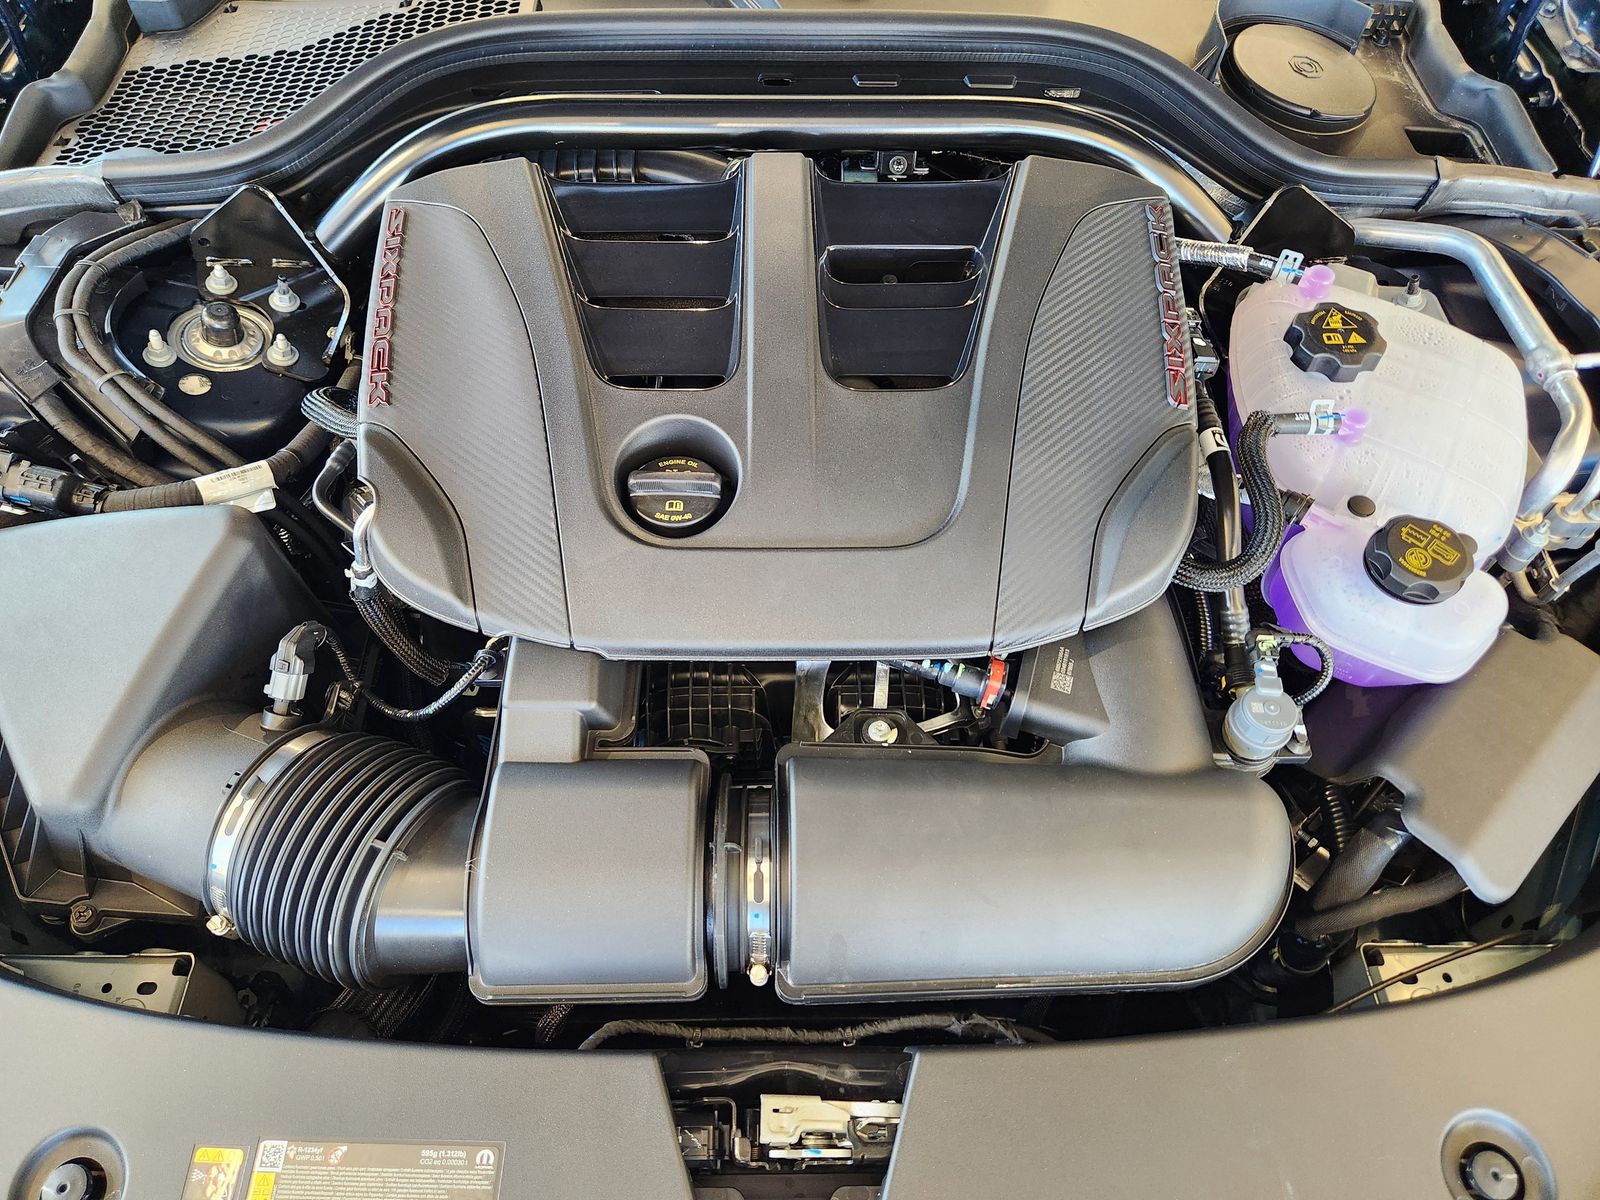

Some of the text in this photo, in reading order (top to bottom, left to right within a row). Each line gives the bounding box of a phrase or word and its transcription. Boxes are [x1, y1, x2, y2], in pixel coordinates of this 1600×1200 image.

[367, 207, 407, 407] SIXPACK
[1145, 203, 1189, 410] SIXPACK
[658, 459, 699, 469] ENGINE OIL
[655, 512, 692, 522] SAE 0W-40
[421, 1149, 438, 1158] 595g
